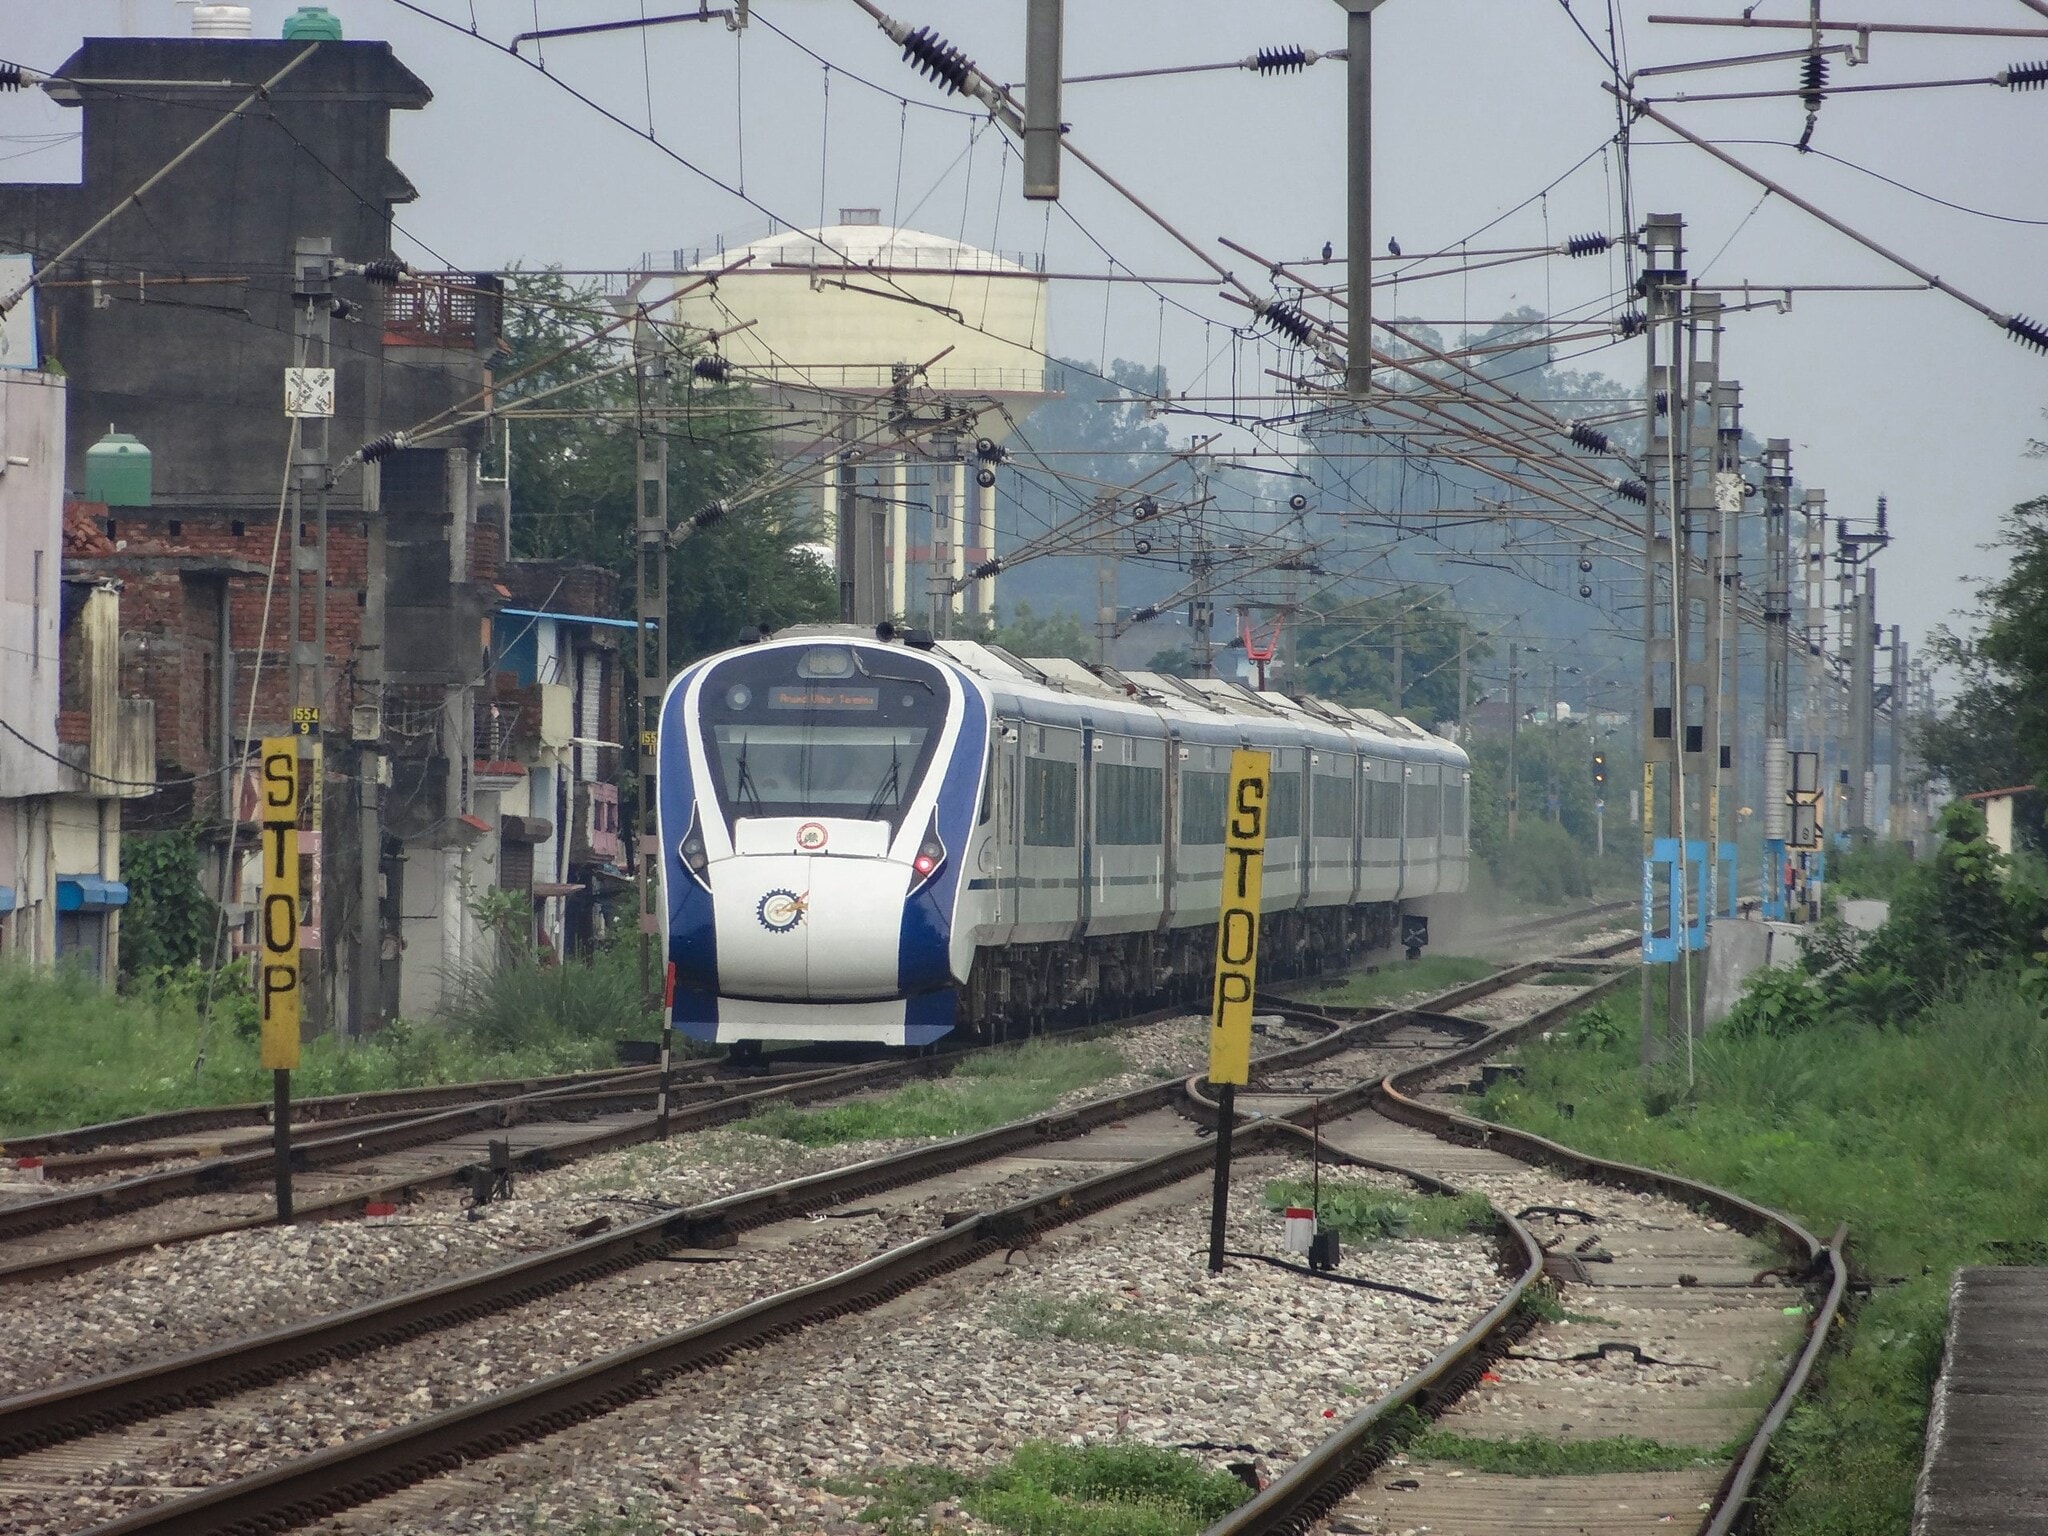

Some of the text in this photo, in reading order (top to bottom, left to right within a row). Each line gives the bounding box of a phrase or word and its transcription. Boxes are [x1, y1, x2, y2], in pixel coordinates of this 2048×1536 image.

[293, 708, 319, 720] 1554
[300, 722, 310, 735] 9
[641, 732, 657, 744] 155
[264, 753, 297, 1021] STOP
[1217, 778, 1265, 1028] STOP
